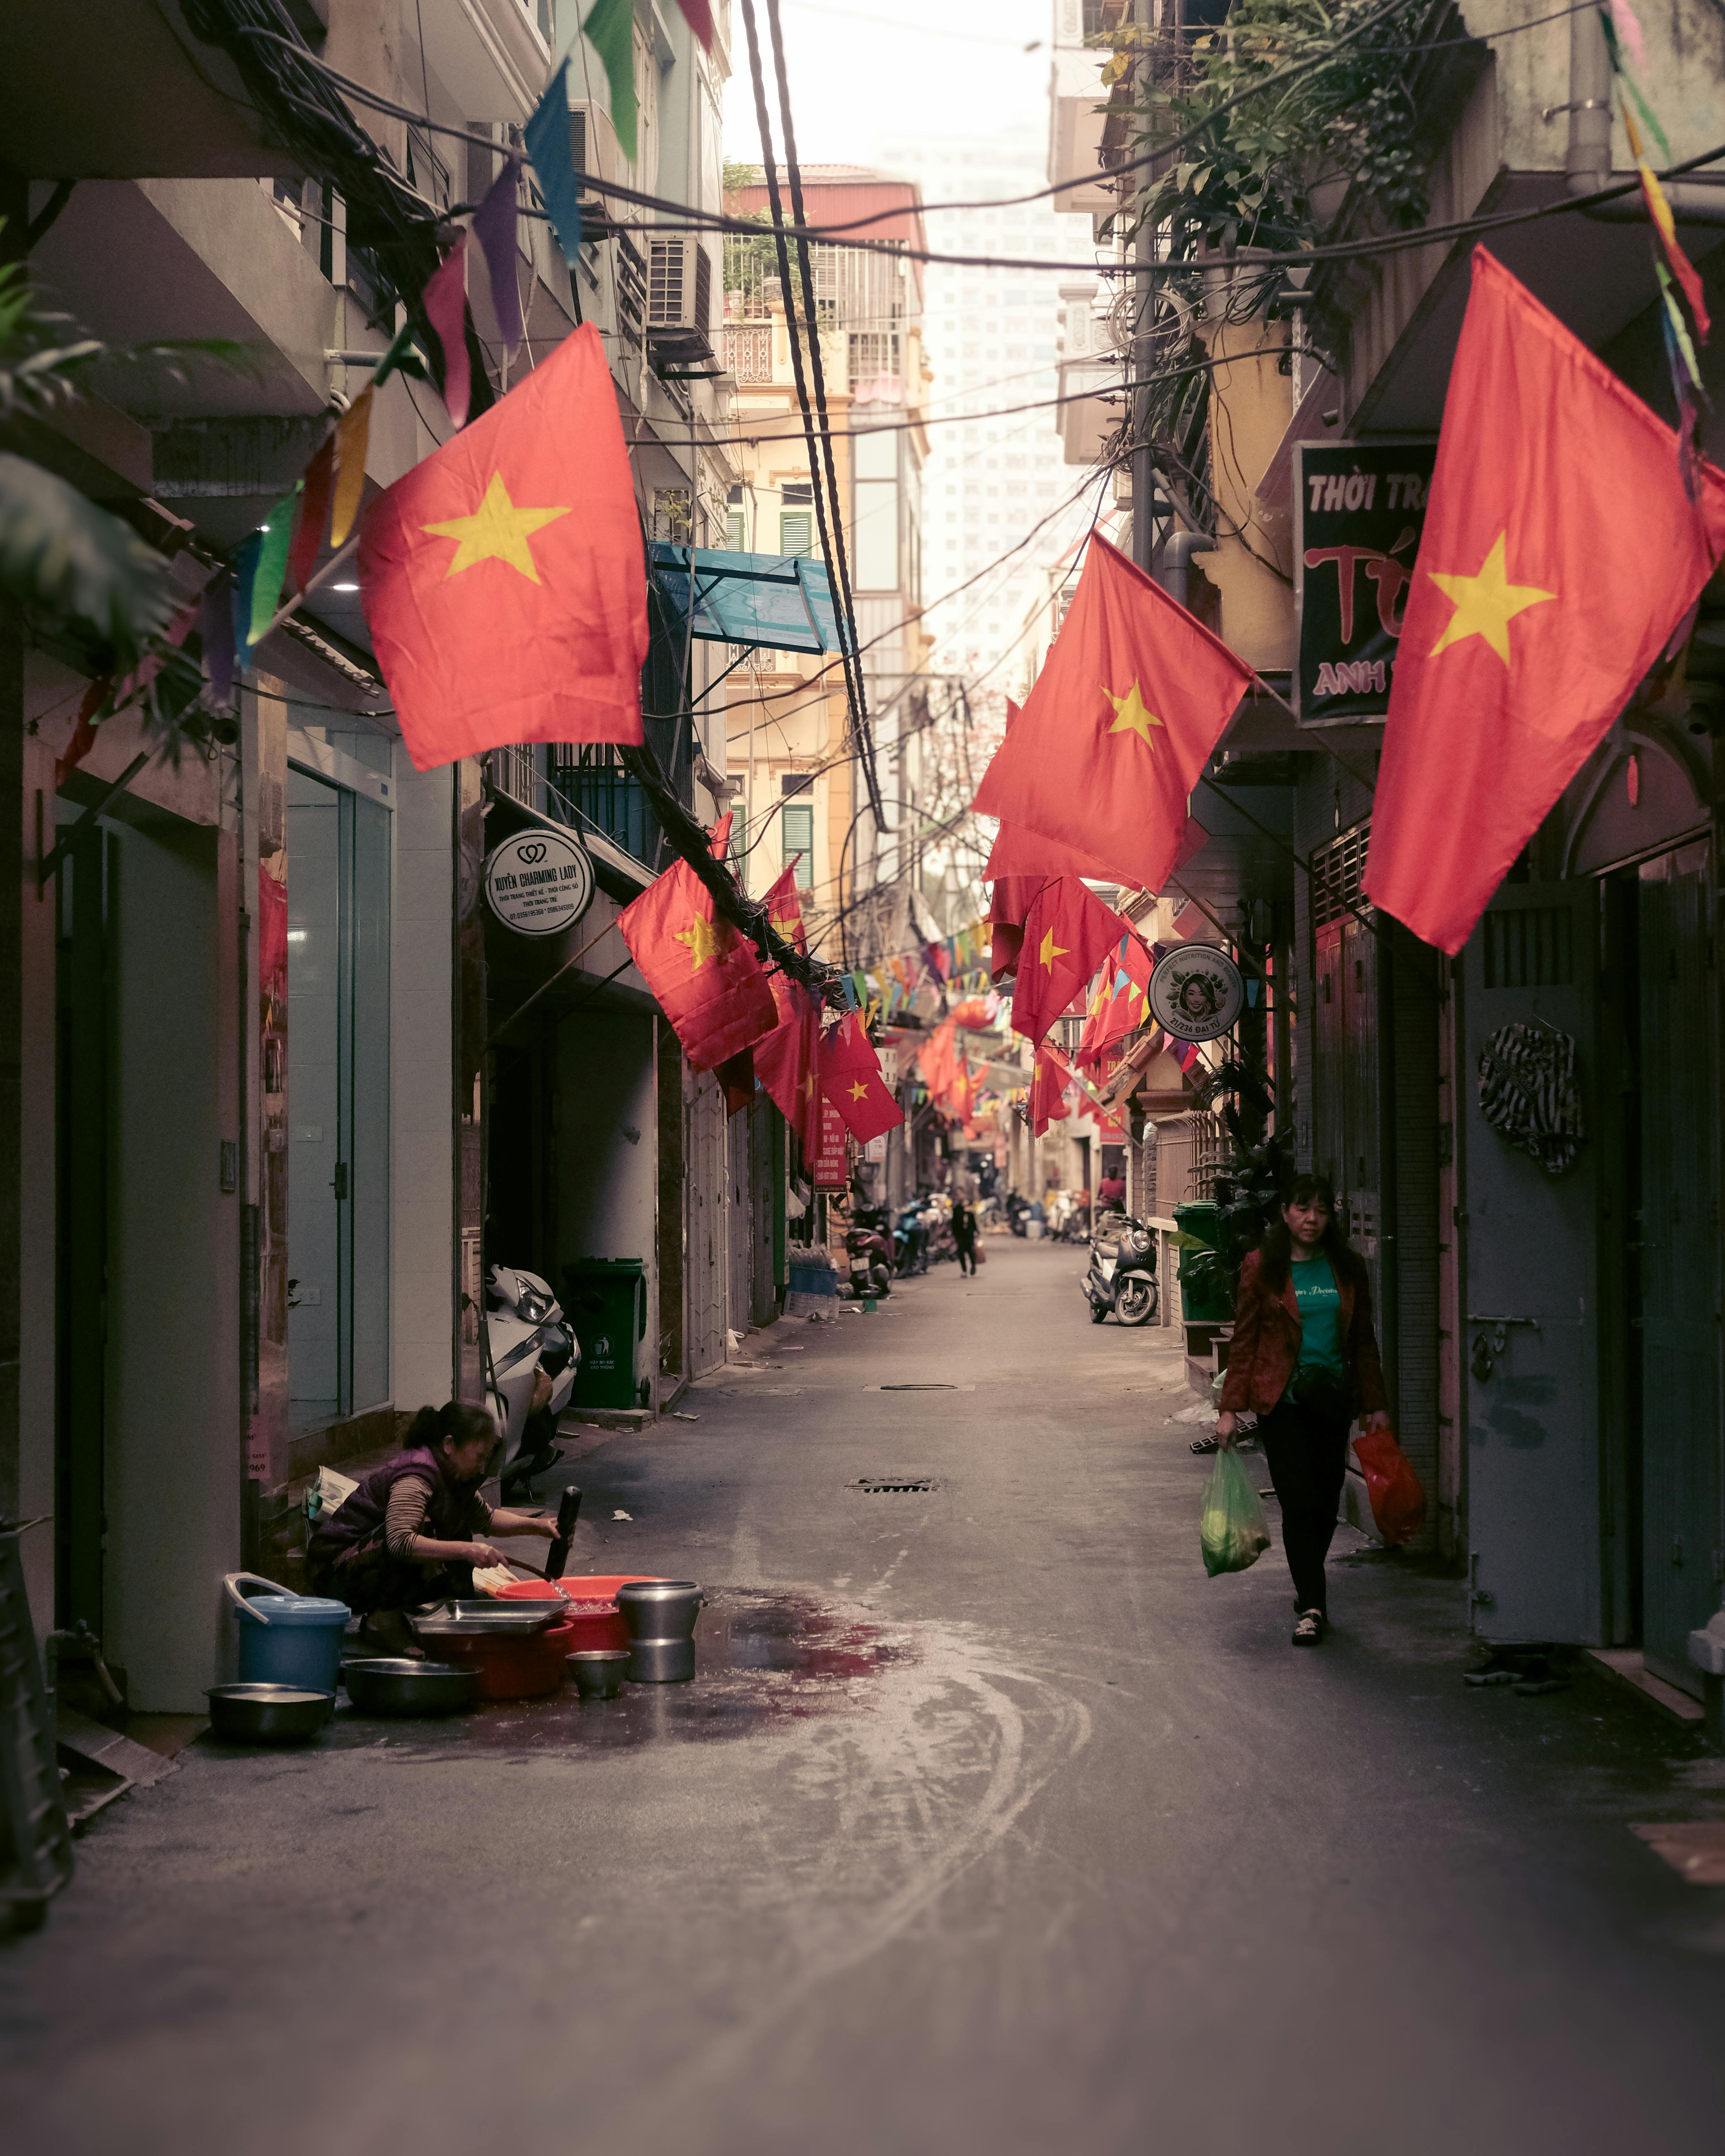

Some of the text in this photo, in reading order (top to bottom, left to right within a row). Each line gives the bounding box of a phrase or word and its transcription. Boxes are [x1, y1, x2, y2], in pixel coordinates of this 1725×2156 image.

[1308, 465, 1377, 512] THỜI
[1312, 660, 1386, 696] ANH
[495, 864, 576, 891] XUYÊN CHARMING LADY
[1160, 953, 1238, 989] PERFECT NUTRITION AND BEAUTY
[1170, 1017, 1193, 1032] 21/236
